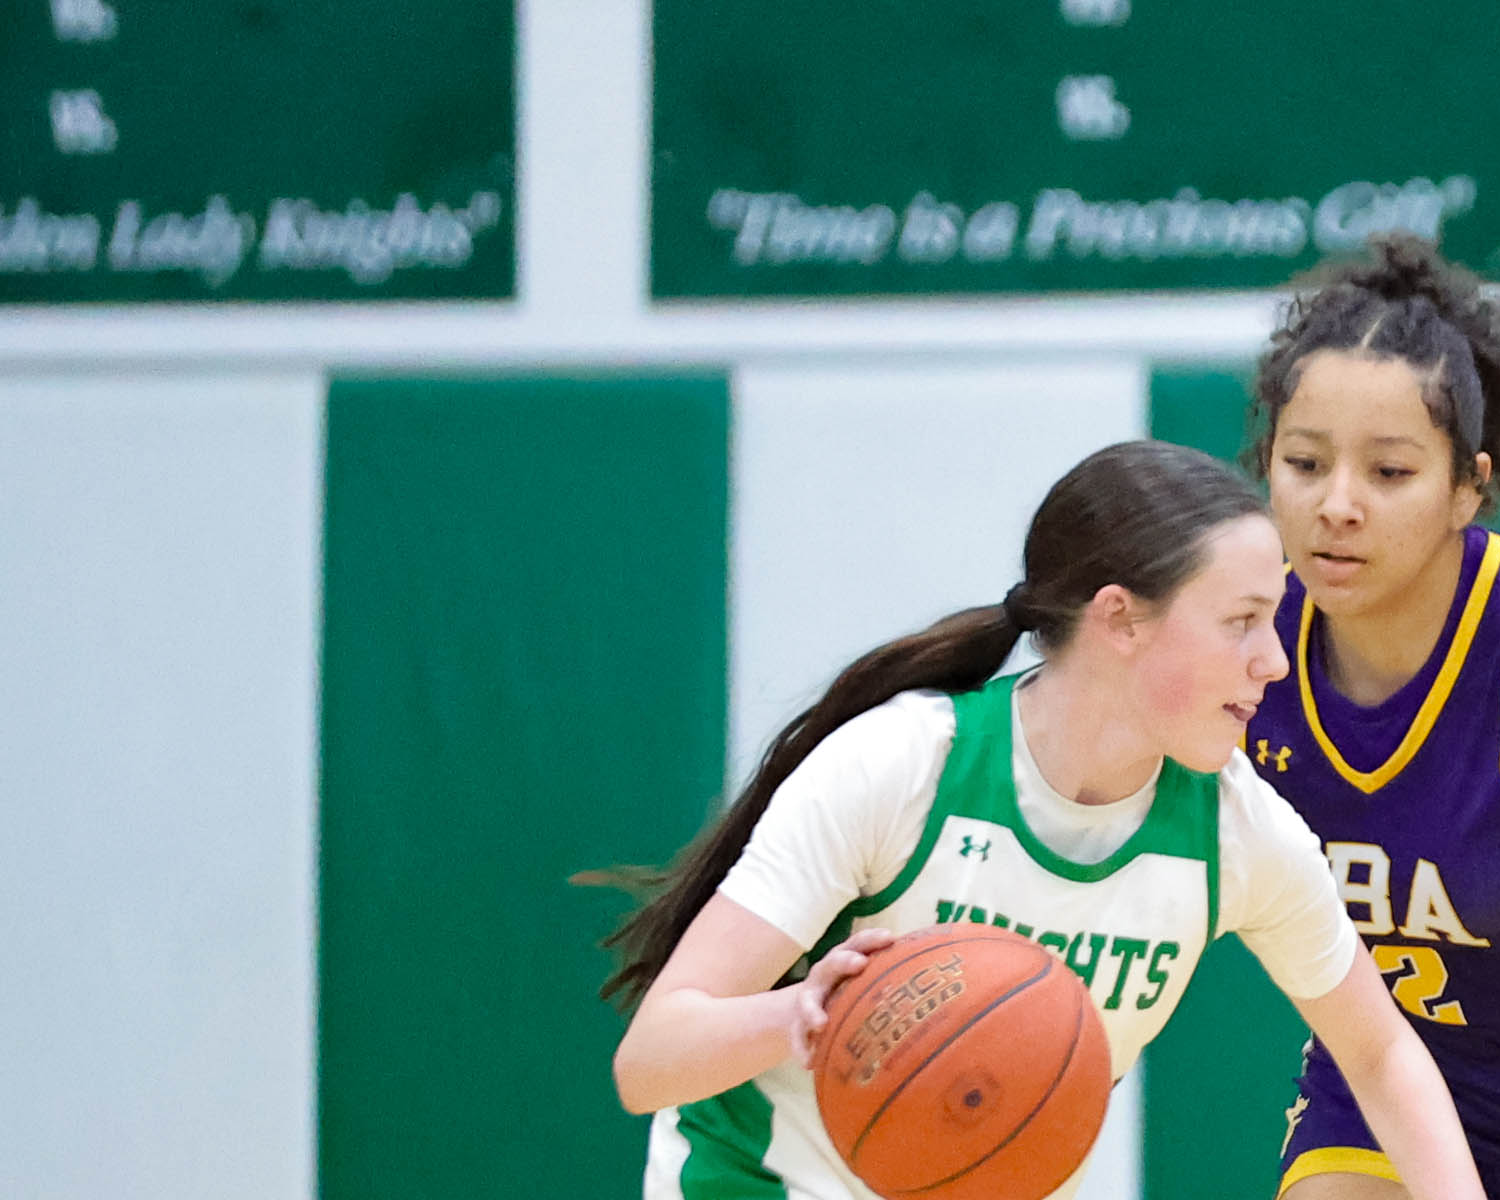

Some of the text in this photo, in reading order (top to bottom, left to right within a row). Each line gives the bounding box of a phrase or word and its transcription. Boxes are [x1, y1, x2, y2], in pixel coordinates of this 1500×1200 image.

[108, 196, 255, 286] Lady
[897, 190, 959, 262] is
[961, 201, 1018, 262] a
[1026, 187, 1312, 259] Precious
[1370, 944, 1469, 1027] 2
